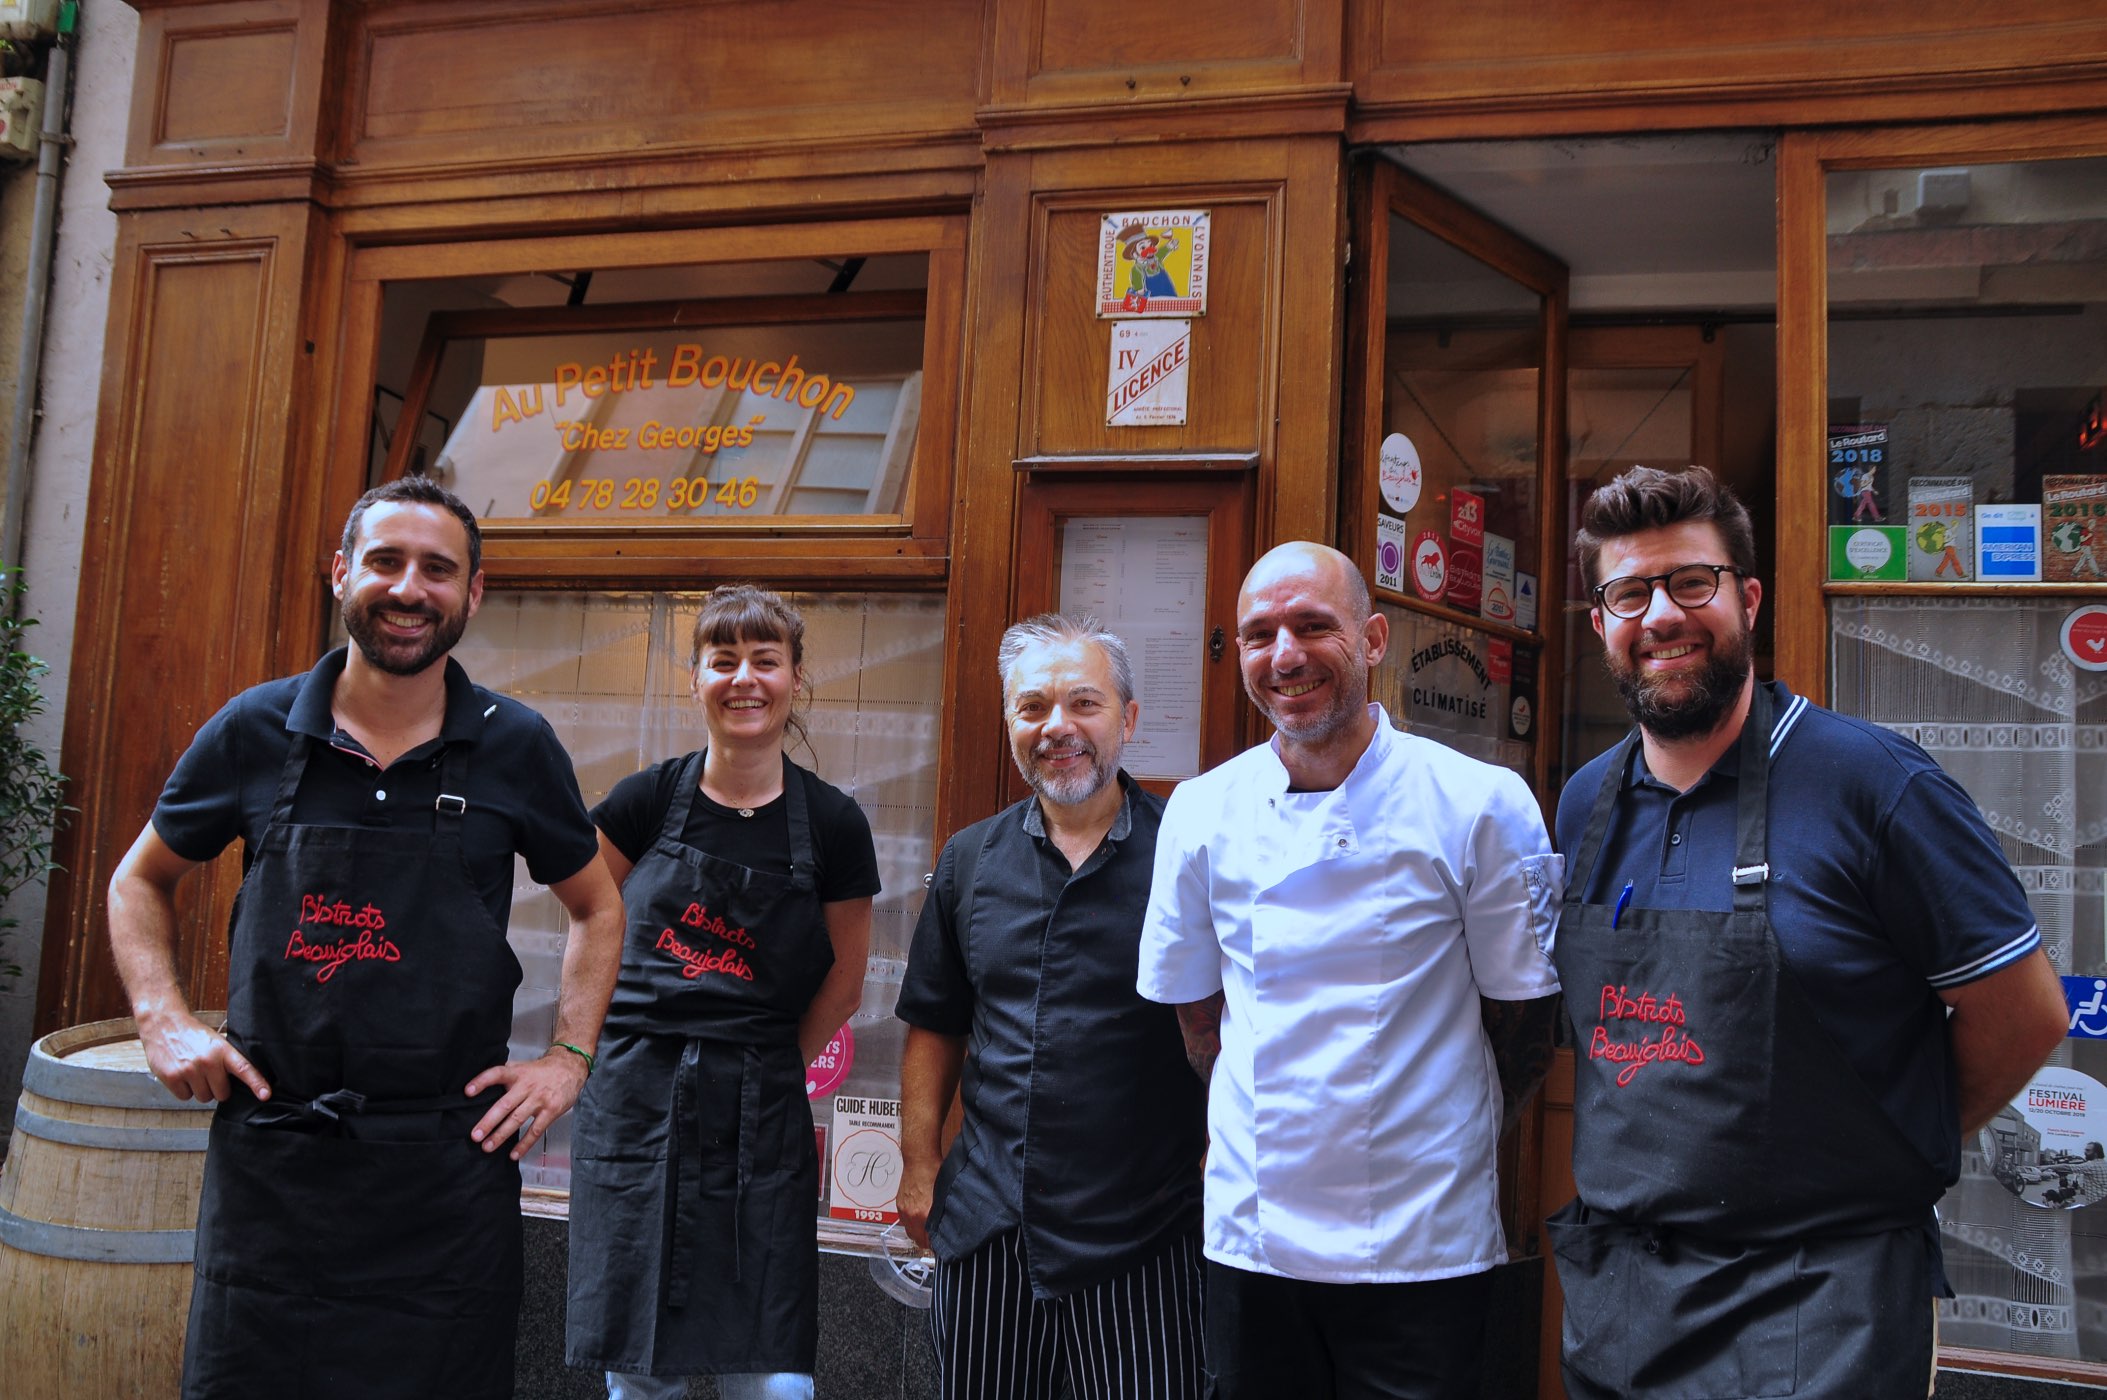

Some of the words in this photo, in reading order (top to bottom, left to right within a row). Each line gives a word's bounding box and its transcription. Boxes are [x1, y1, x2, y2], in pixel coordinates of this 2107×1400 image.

[1122, 215, 1191, 228] BOUCHON
[1102, 229, 1116, 301] AUTHENTIQUE
[1191, 226, 1206, 298] LYONNAIS
[1118, 349, 1140, 370] IV
[1113, 340, 1185, 412] LICENCE
[491, 382, 544, 432] Au
[554, 347, 657, 407] Petit
[667, 343, 856, 420] Bouchon
[1831, 449, 1883, 463] 2018
[529, 478, 571, 511] 04
[577, 478, 615, 511] 78
[620, 477, 660, 510] 28
[667, 477, 708, 509] 30
[715, 475, 759, 510] 46
[1914, 502, 1967, 517] 2015
[2048, 502, 2107, 517] 2016
[1377, 517, 1404, 534] SAVEURS
[1981, 542, 2034, 552] AMERICAN
[1992, 552, 2036, 562] EXPRESS
[1380, 573, 1397, 587] 2011
[299, 894, 386, 930] Bistrots
[680, 902, 757, 950] Bistrots
[284, 930, 401, 984] Beaujolais
[656, 927, 754, 981] Beaujolais
[1600, 985, 1686, 1027] Bistrots
[1588, 1025, 1705, 1088] Beaujolais
[2029, 1088, 2086, 1102] FESTIVAL
[836, 1097, 866, 1115] GUIDE
[854, 1209, 884, 1221] 1993
